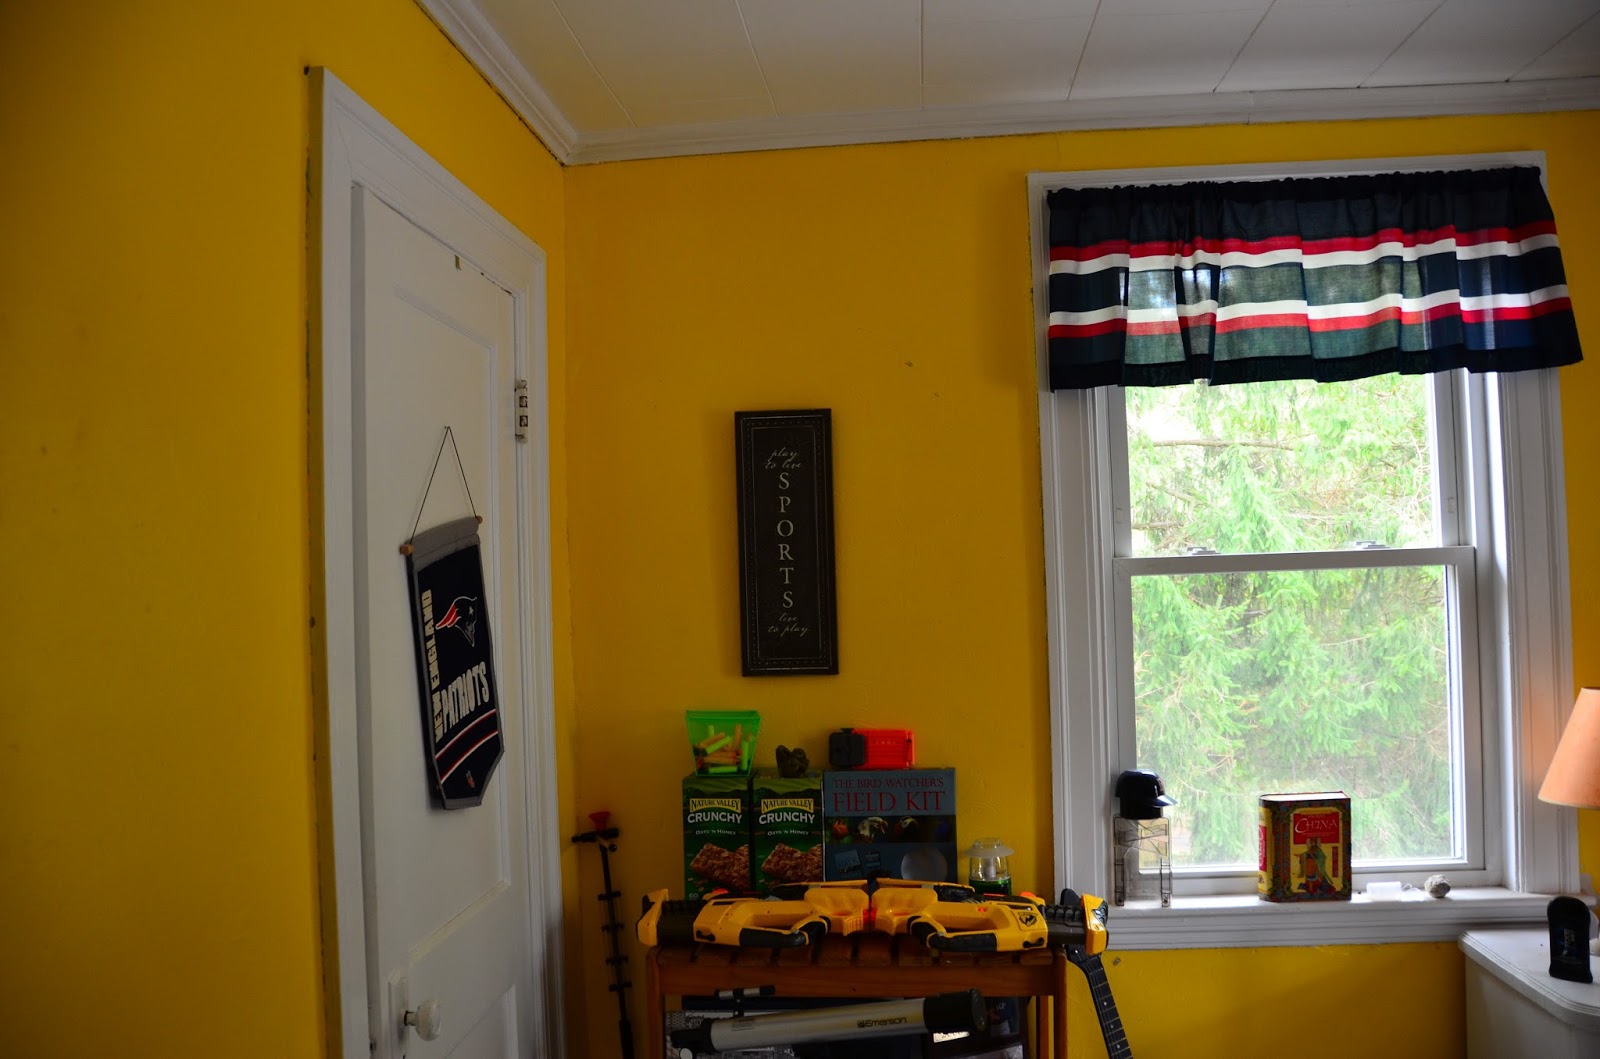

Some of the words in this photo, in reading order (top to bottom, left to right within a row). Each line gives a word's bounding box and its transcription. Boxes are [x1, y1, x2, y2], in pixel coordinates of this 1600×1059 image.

[767, 447, 798, 462] play
[765, 461, 777, 469] to
[777, 472, 794, 608] SPORTS
[767, 625, 779, 633] to
[780, 623, 808, 637] play
[421, 588, 441, 691] ENGLAND
[441, 661, 490, 734] PATRIOTS
[431, 690, 444, 744] NEW
[833, 780, 855, 789] THE
[857, 779, 881, 789] BIRD
[885, 778, 944, 788] WATCHER'S
[691, 799, 716, 811] NATURE
[716, 799, 740, 811] VALLEY
[762, 799, 788, 812] NATURE
[788, 799, 813, 811] VALLEY
[833, 791, 896, 812] FIELD
[906, 791, 945, 811] KIT
[687, 812, 743, 824] CRUNCHY
[758, 812, 815, 825] CRUNCHY
[1295, 818, 1337, 833] CHINA
[865, 1017, 907, 1027] Emerson
